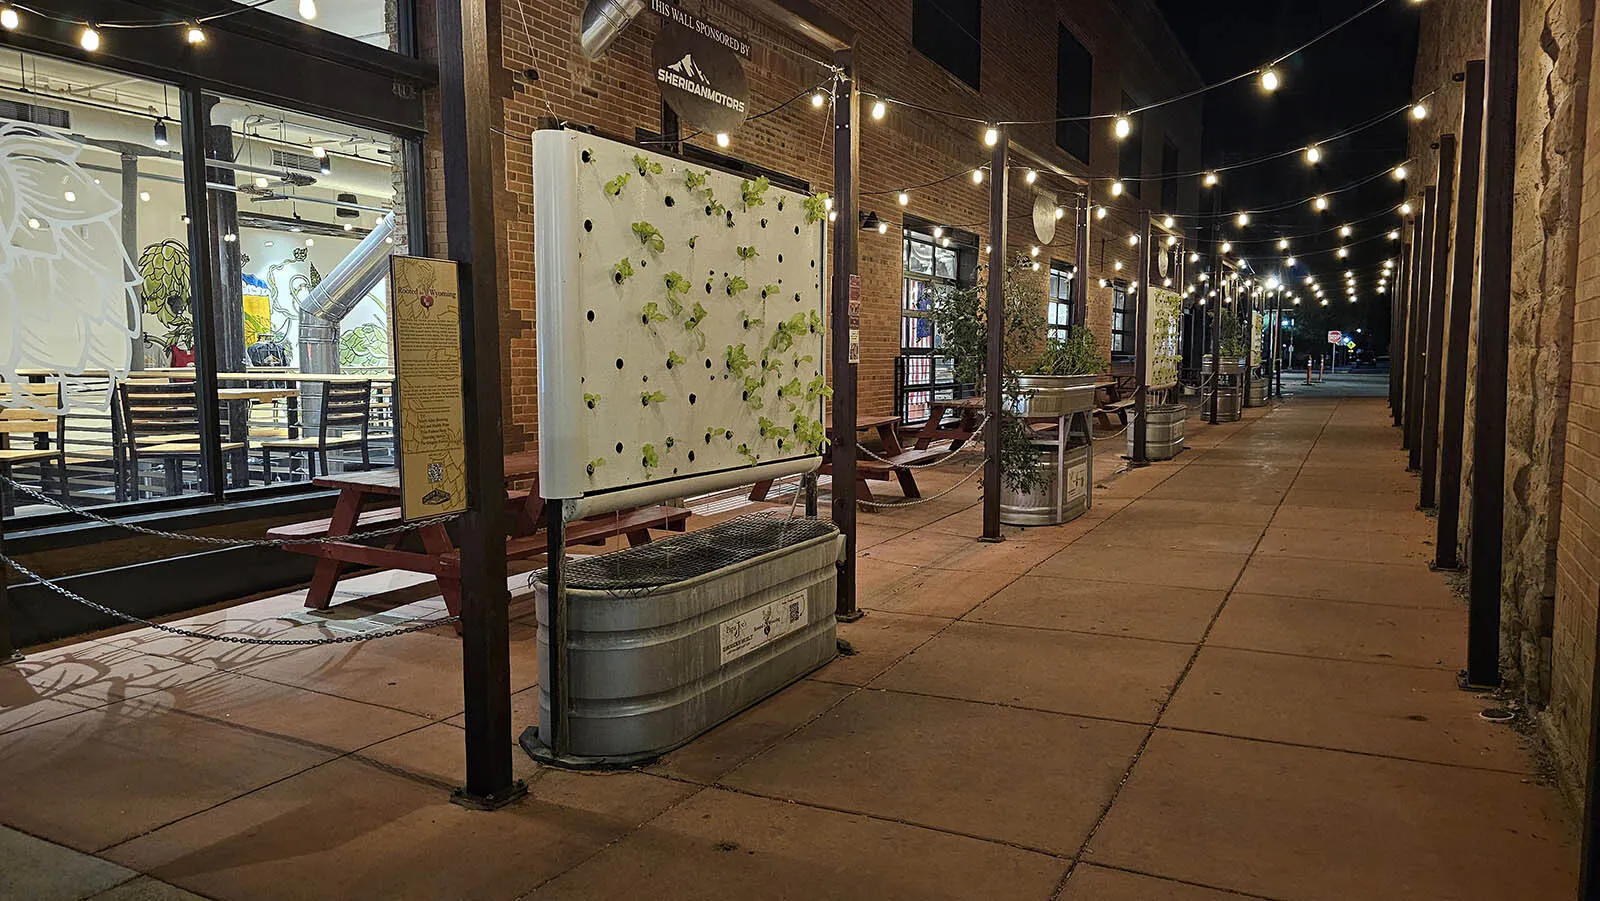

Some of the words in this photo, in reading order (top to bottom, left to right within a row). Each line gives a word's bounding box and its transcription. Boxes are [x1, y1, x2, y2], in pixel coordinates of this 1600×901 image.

[651, 0, 670, 17] THIS
[671, 7, 694, 30] WALL
[695, 20, 740, 51] SPONSORED
[740, 42, 751, 57] BY
